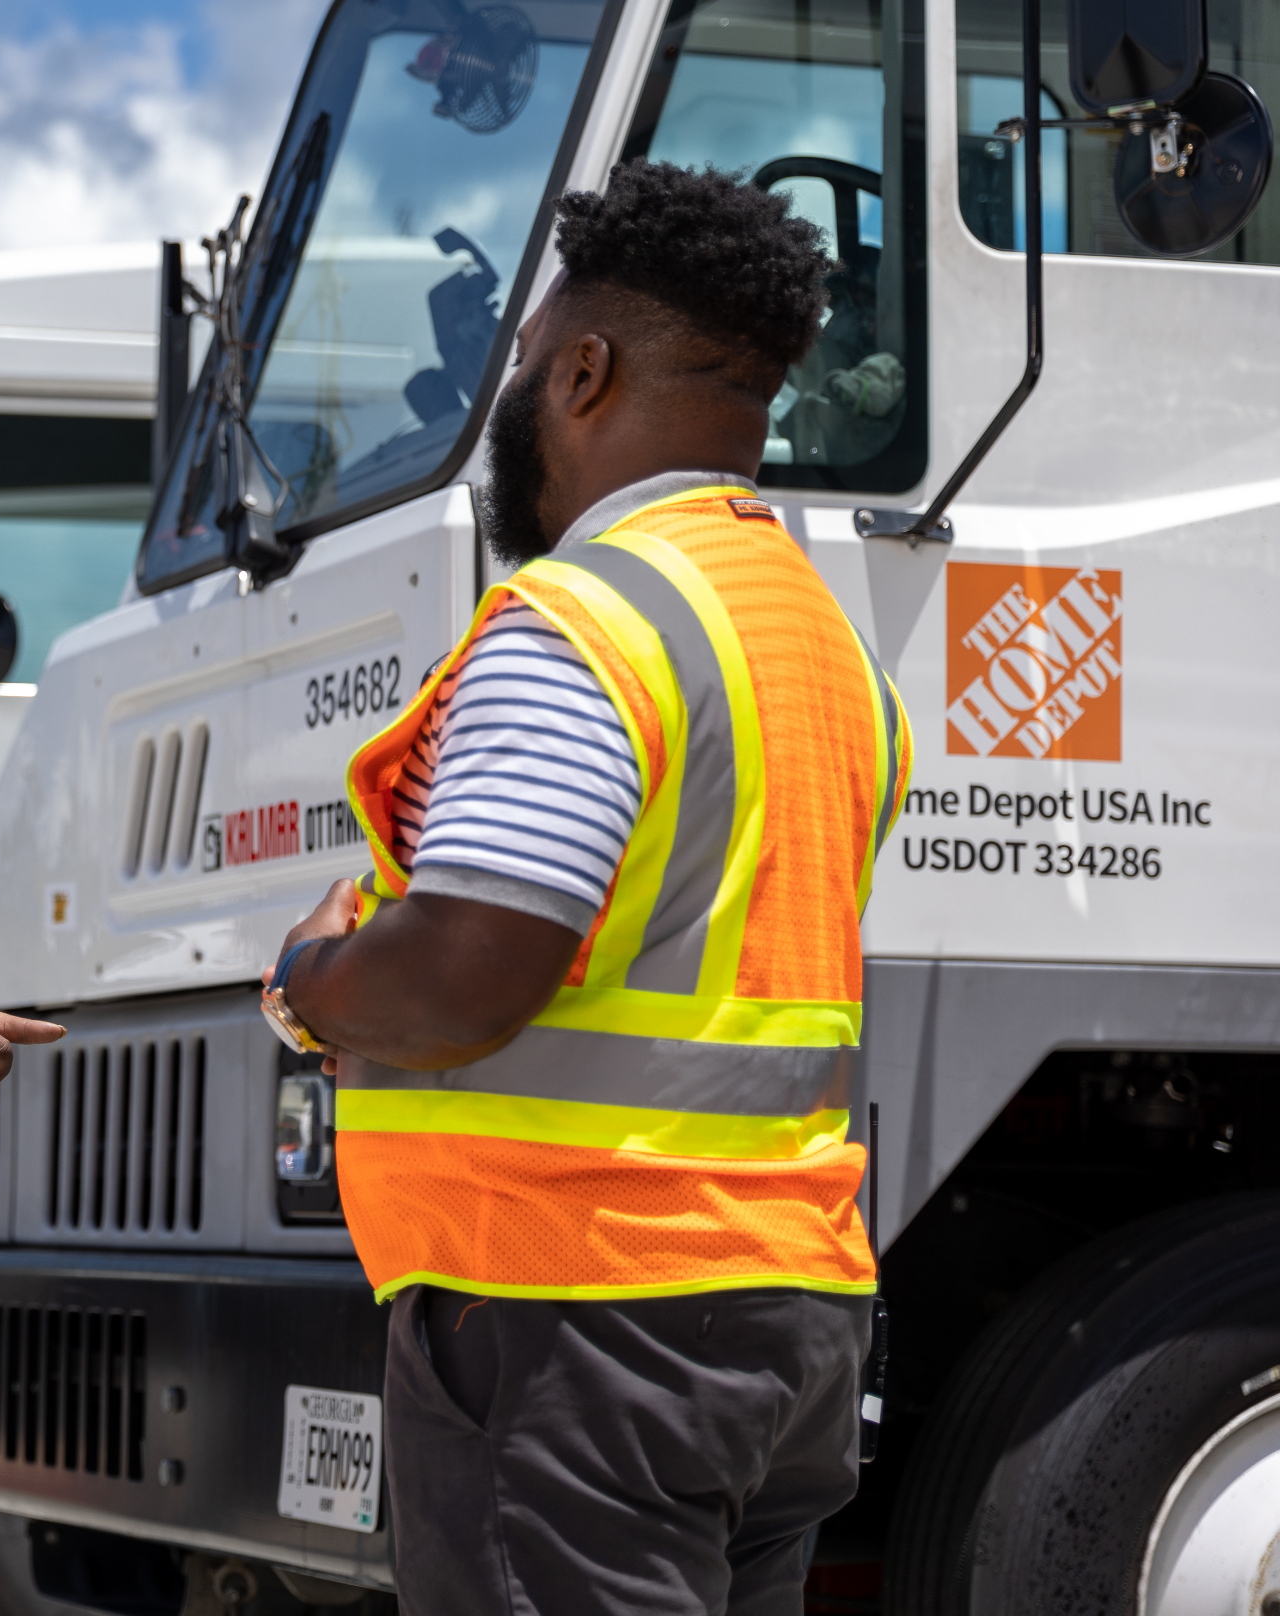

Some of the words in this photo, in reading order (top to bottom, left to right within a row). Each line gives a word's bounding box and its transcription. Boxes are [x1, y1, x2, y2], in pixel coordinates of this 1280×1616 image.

[961, 583, 1037, 660] THE
[305, 655, 401, 729] 354682
[946, 565, 1122, 758] HOME
[1015, 639, 1122, 760] DEPOT
[224, 800, 301, 868] KALMAR
[305, 799, 368, 855] OTTAW
[904, 786, 959, 815] me
[969, 784, 1074, 827] Depot
[1083, 789, 1153, 824] USA
[1162, 793, 1212, 826] Inc
[903, 836, 1026, 873] USDOT
[1035, 843, 1161, 878] 334286
[307, 1425, 374, 1492] ERH099
